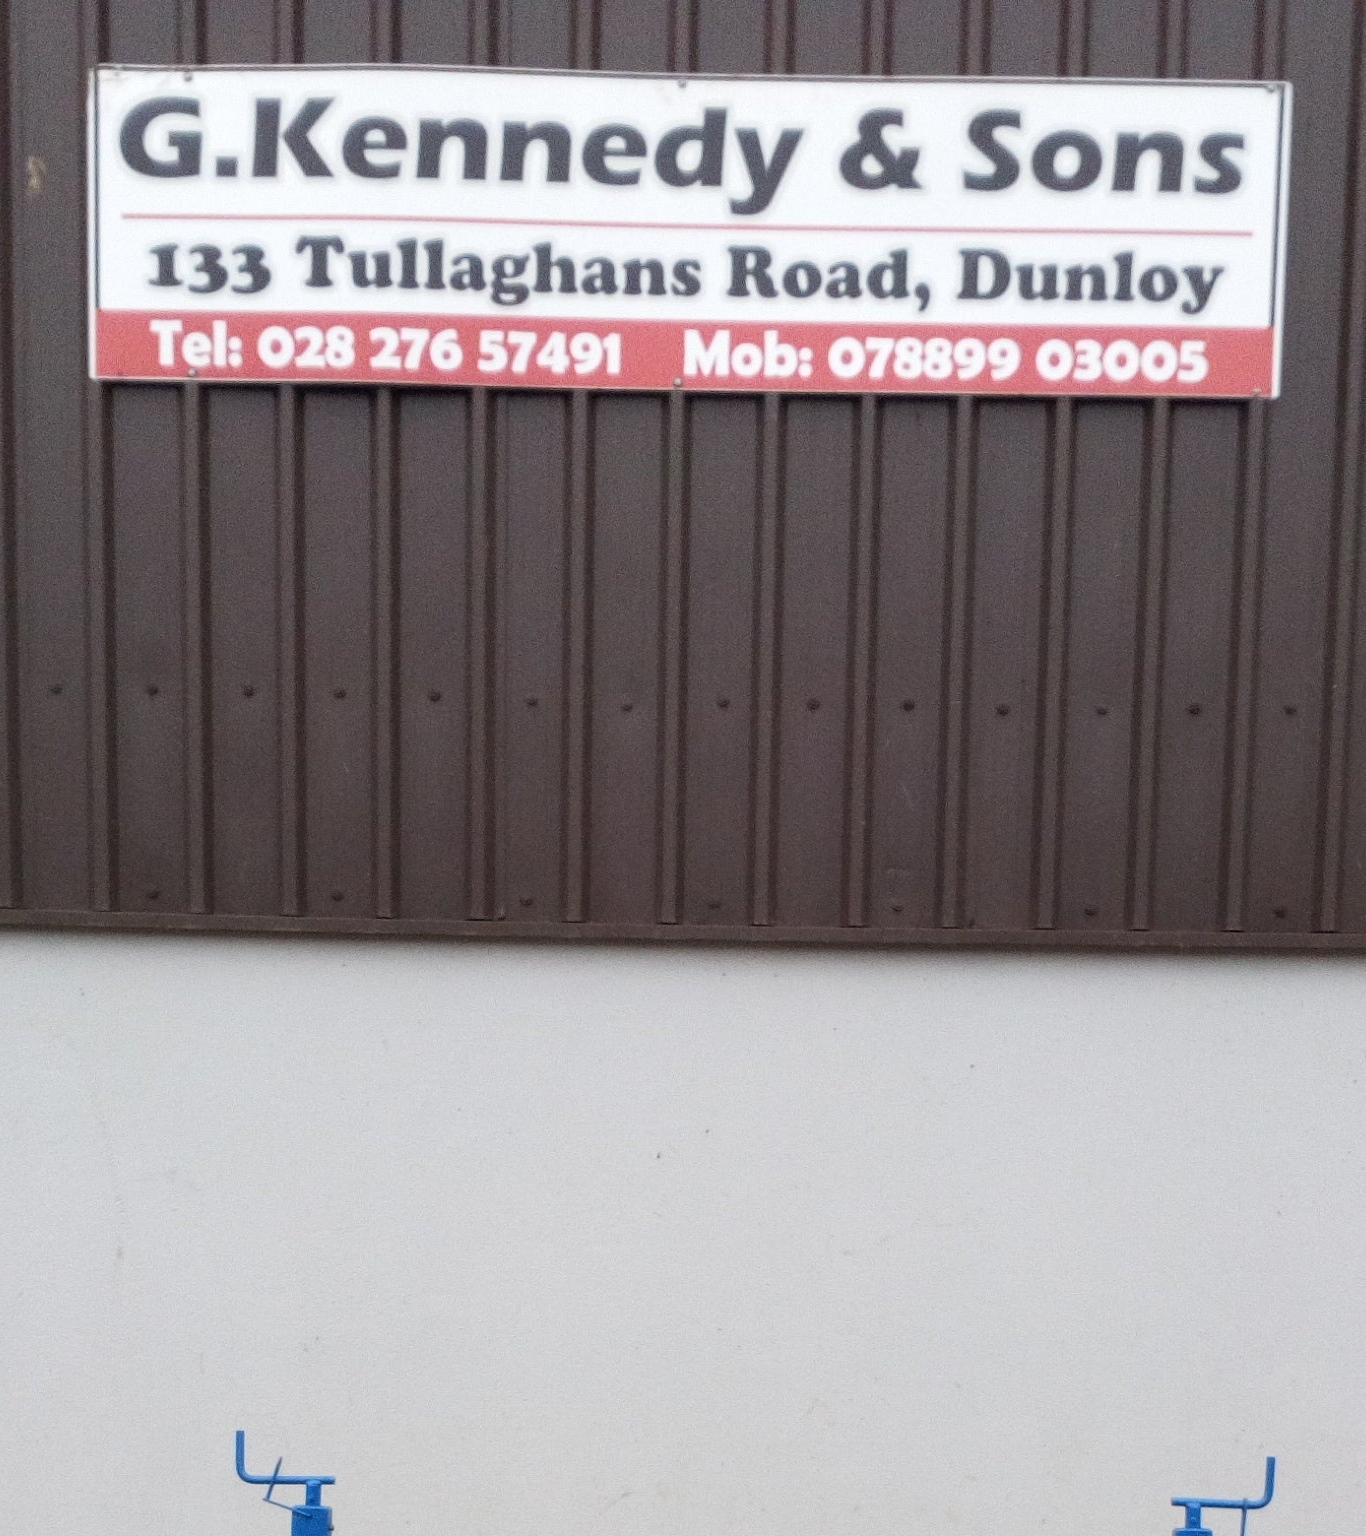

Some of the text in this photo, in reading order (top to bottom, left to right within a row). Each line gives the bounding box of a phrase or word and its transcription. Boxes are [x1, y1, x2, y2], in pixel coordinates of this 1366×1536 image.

[118, 96, 1245, 216] G.Kennedy & Sons
[147, 234, 1226, 315] 133 Tullaghans Road, Dunloy
[149, 319, 1208, 384] Tel: 028 276 57491 Mob: 078899 03005
